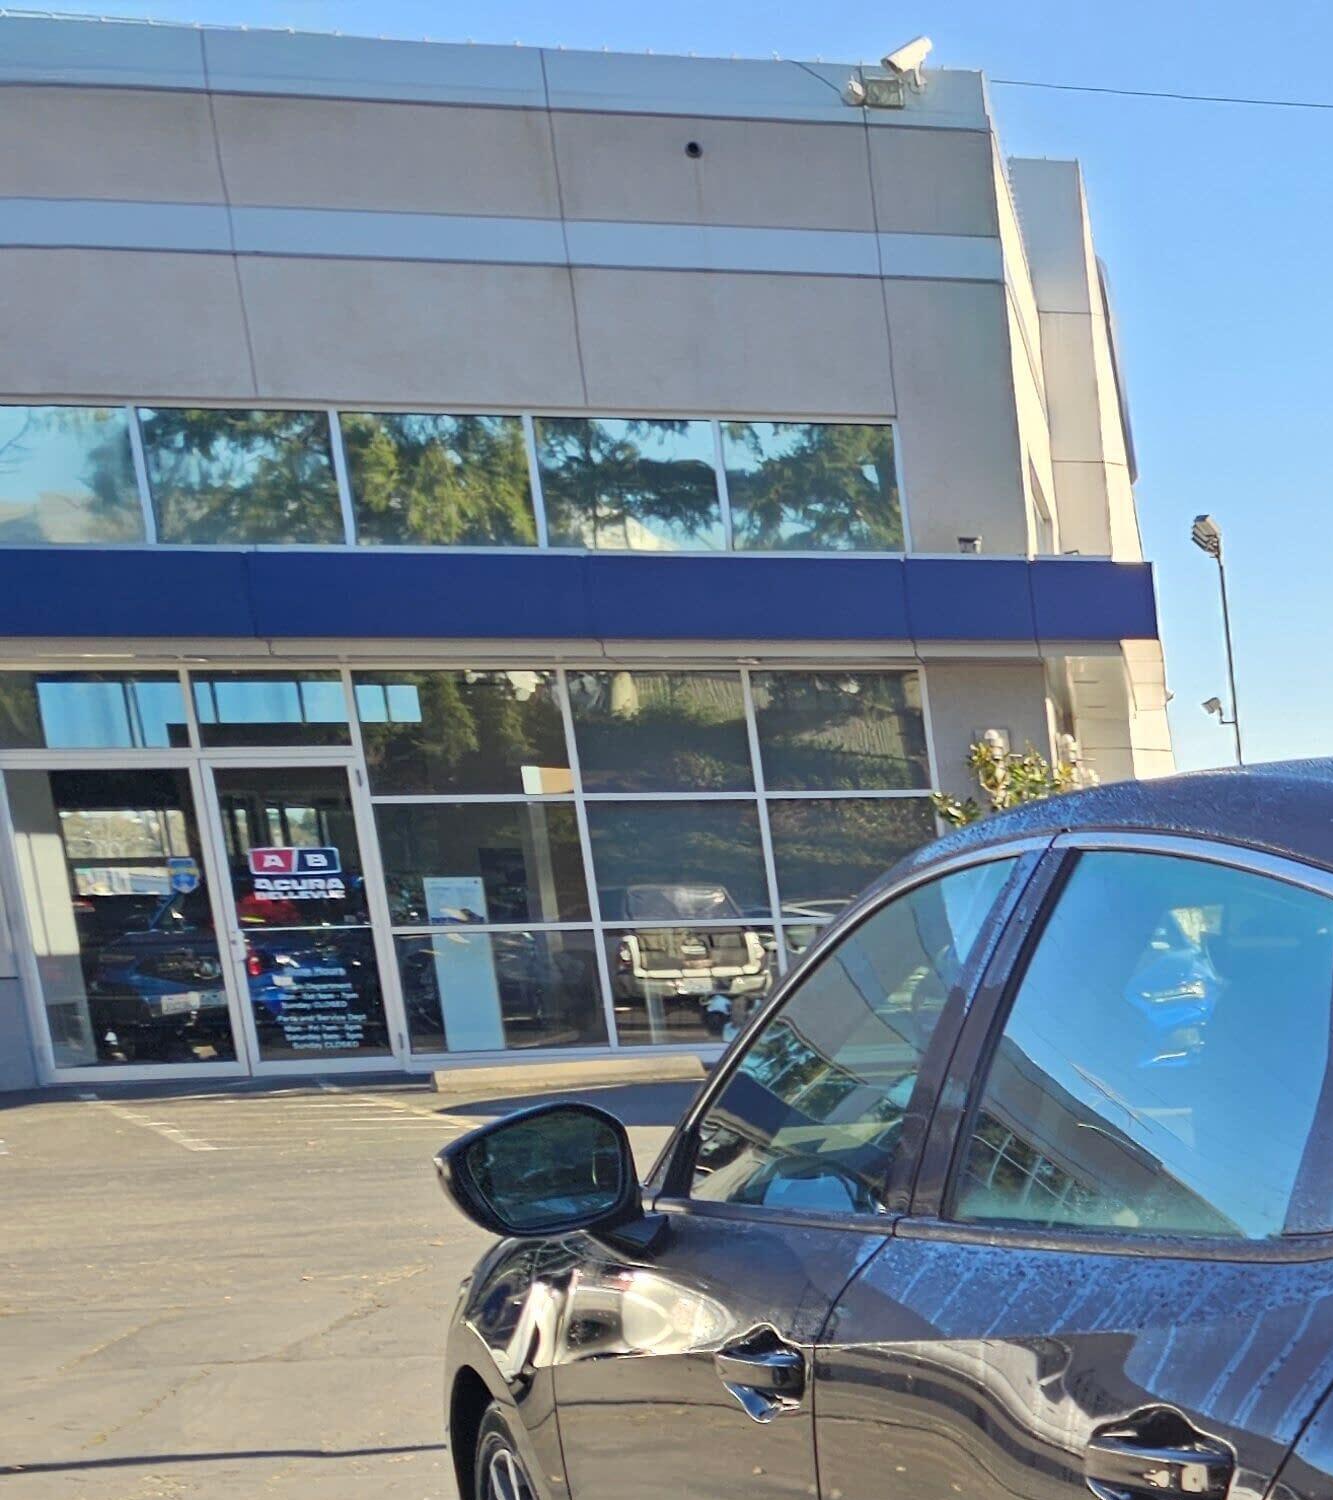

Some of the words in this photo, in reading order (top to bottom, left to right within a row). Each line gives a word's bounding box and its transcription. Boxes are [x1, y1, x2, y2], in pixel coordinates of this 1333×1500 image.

[262, 854, 285, 868] A
[304, 854, 328, 867] B
[253, 878, 346, 891] ACURA
[324, 1040, 360, 1049] CLOSED
